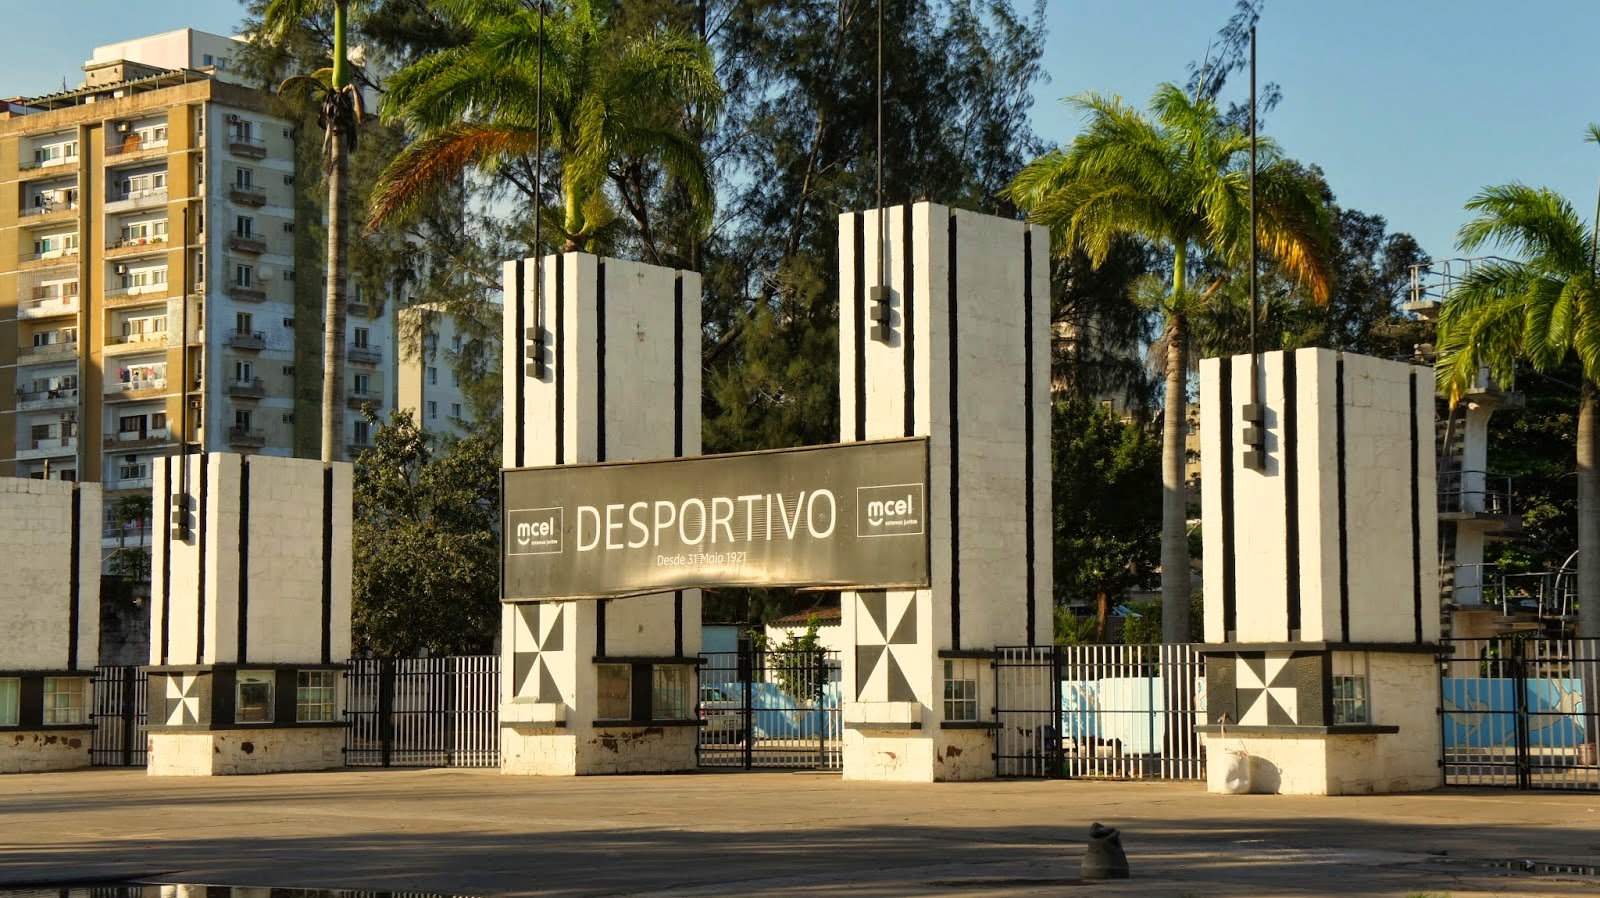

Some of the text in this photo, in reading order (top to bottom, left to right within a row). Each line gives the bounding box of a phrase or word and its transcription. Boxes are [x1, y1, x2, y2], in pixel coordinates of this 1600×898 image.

[867, 494, 913, 517] mcel
[517, 517, 554, 537] mcel
[576, 488, 837, 552] DESPORTIVO
[903, 519, 918, 527] juntos
[657, 551, 747, 566] Desde 31 Maio 1921
